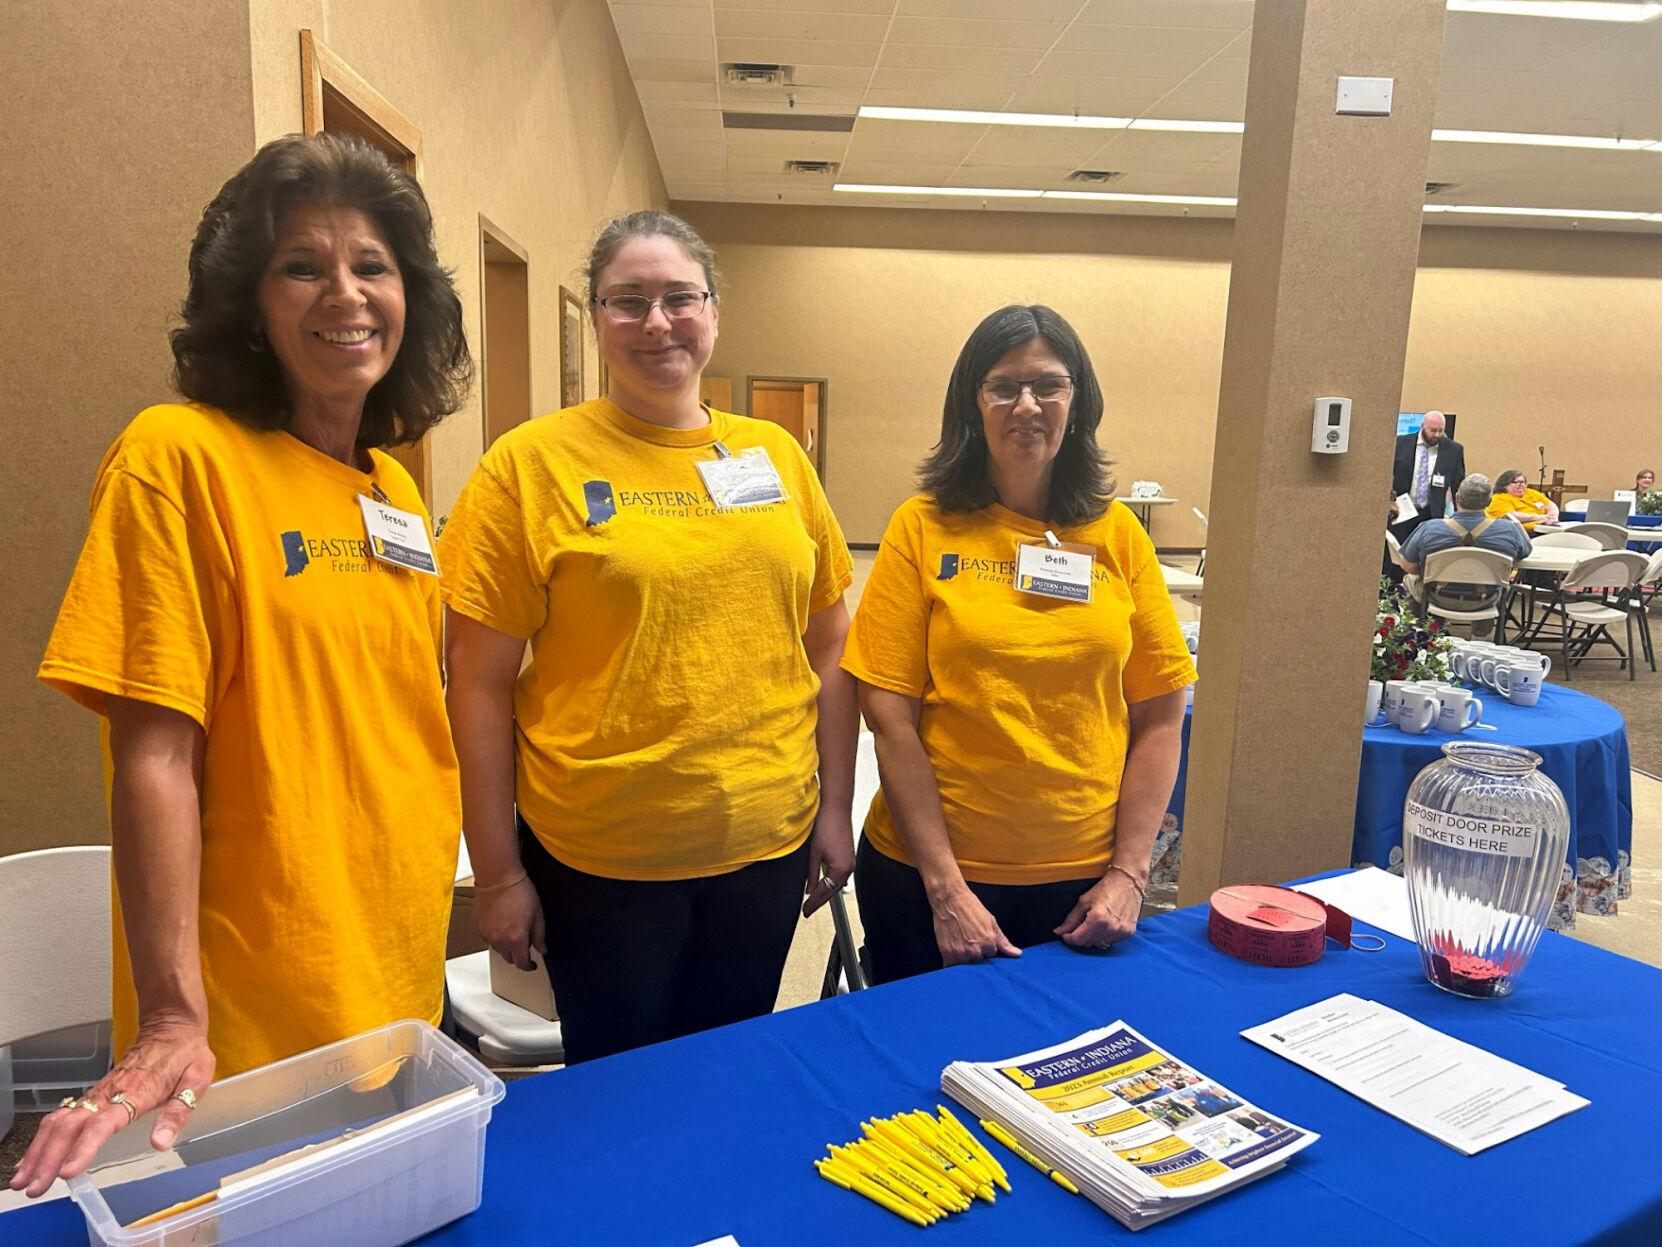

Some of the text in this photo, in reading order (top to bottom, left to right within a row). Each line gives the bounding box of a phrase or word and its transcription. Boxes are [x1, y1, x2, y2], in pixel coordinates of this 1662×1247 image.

[618, 491, 700, 507] EASTERN
[377, 508, 409, 528] Teresa
[643, 507, 690, 518] Federal
[308, 538, 373, 559] EASTER
[331, 560, 372, 573] Federal
[960, 557, 1017, 575] EASTER
[1044, 554, 1069, 566] Beth
[977, 572, 1014, 585] Federa
[1407, 802, 1533, 839] DEPOSIT DOOR PRIZE
[1417, 824, 1509, 853] TICKETS HERE
[1025, 1036, 1138, 1079] EASTERN INDIANA
[1048, 1048, 1134, 1080] Federal Credit Union
